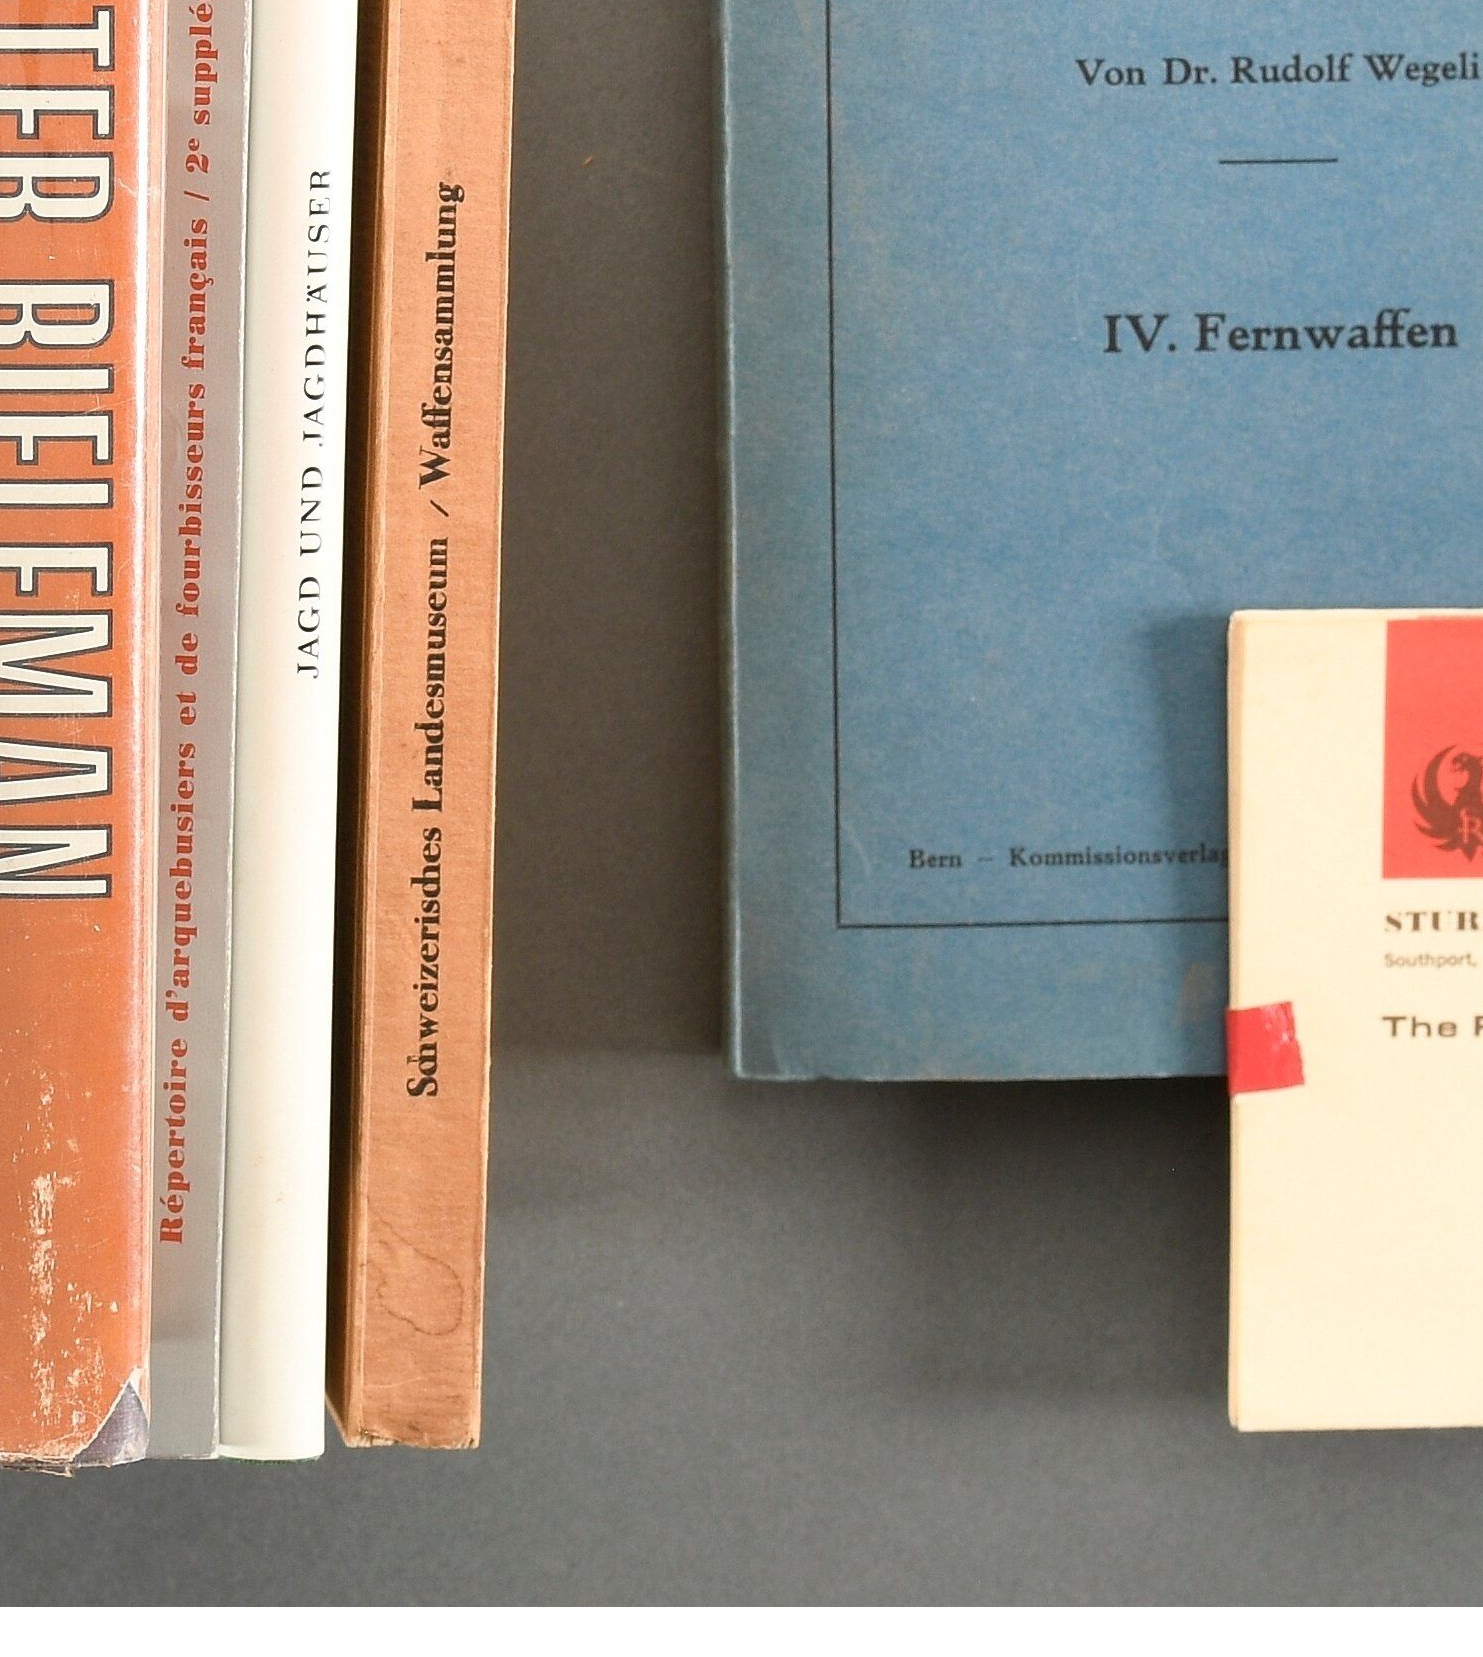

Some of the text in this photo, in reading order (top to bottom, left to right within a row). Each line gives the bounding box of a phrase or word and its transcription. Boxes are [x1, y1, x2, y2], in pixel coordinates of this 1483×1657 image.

[1076, 52, 1480, 86] Von Dr. Rudolf Wegeli
[180, 219, 212, 369] français
[417, 182, 464, 488] Waffensammlung
[1103, 308, 1458, 352] IV. Fernwaffen
[296, 169, 331, 679] JAGD UND JAGDHÄUSER
[176, 384, 206, 616] fourbisseurs
[174, 633, 199, 675] de
[411, 538, 450, 812] Landesmuseum
[175, 692, 197, 725] et
[166, 743, 201, 1021] d'arquebusiers
[909, 849, 961, 869] Bern
[1384, 954, 1477, 969] Southport,
[1383, 1015, 1457, 1038] The
[159, 1038, 191, 1244] Répertoire
